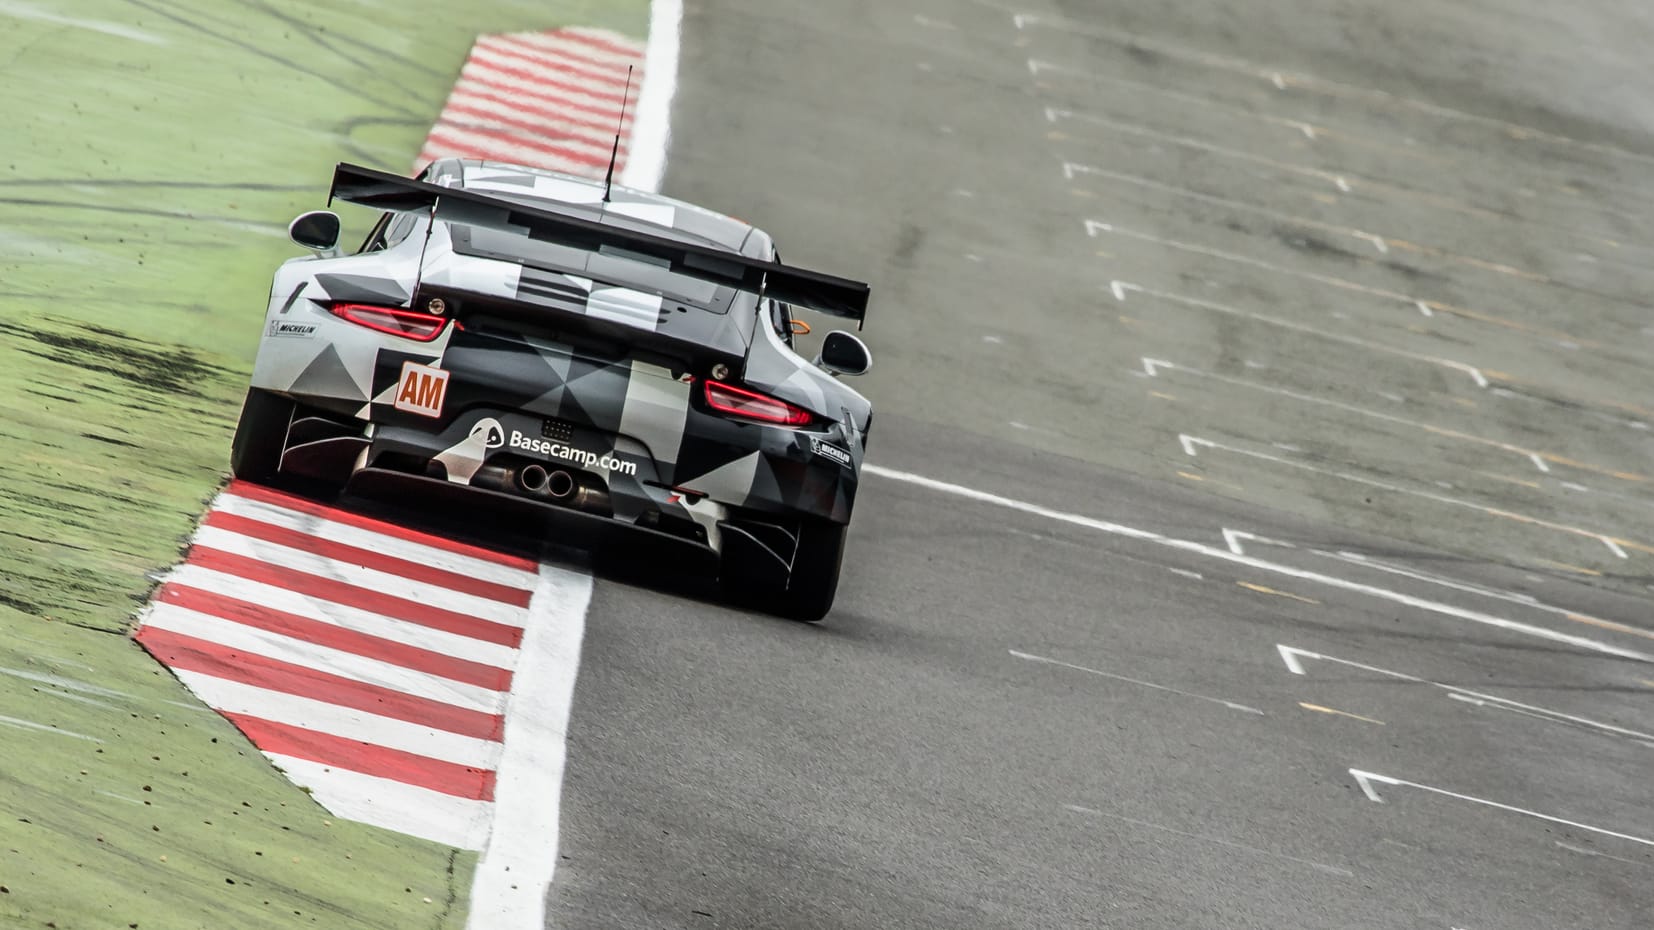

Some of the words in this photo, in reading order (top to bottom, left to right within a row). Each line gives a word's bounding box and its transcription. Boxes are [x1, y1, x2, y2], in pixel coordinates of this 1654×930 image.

[279, 324, 316, 334] MICHELIN
[399, 371, 444, 410] AM
[509, 430, 637, 476] Basecamp.com
